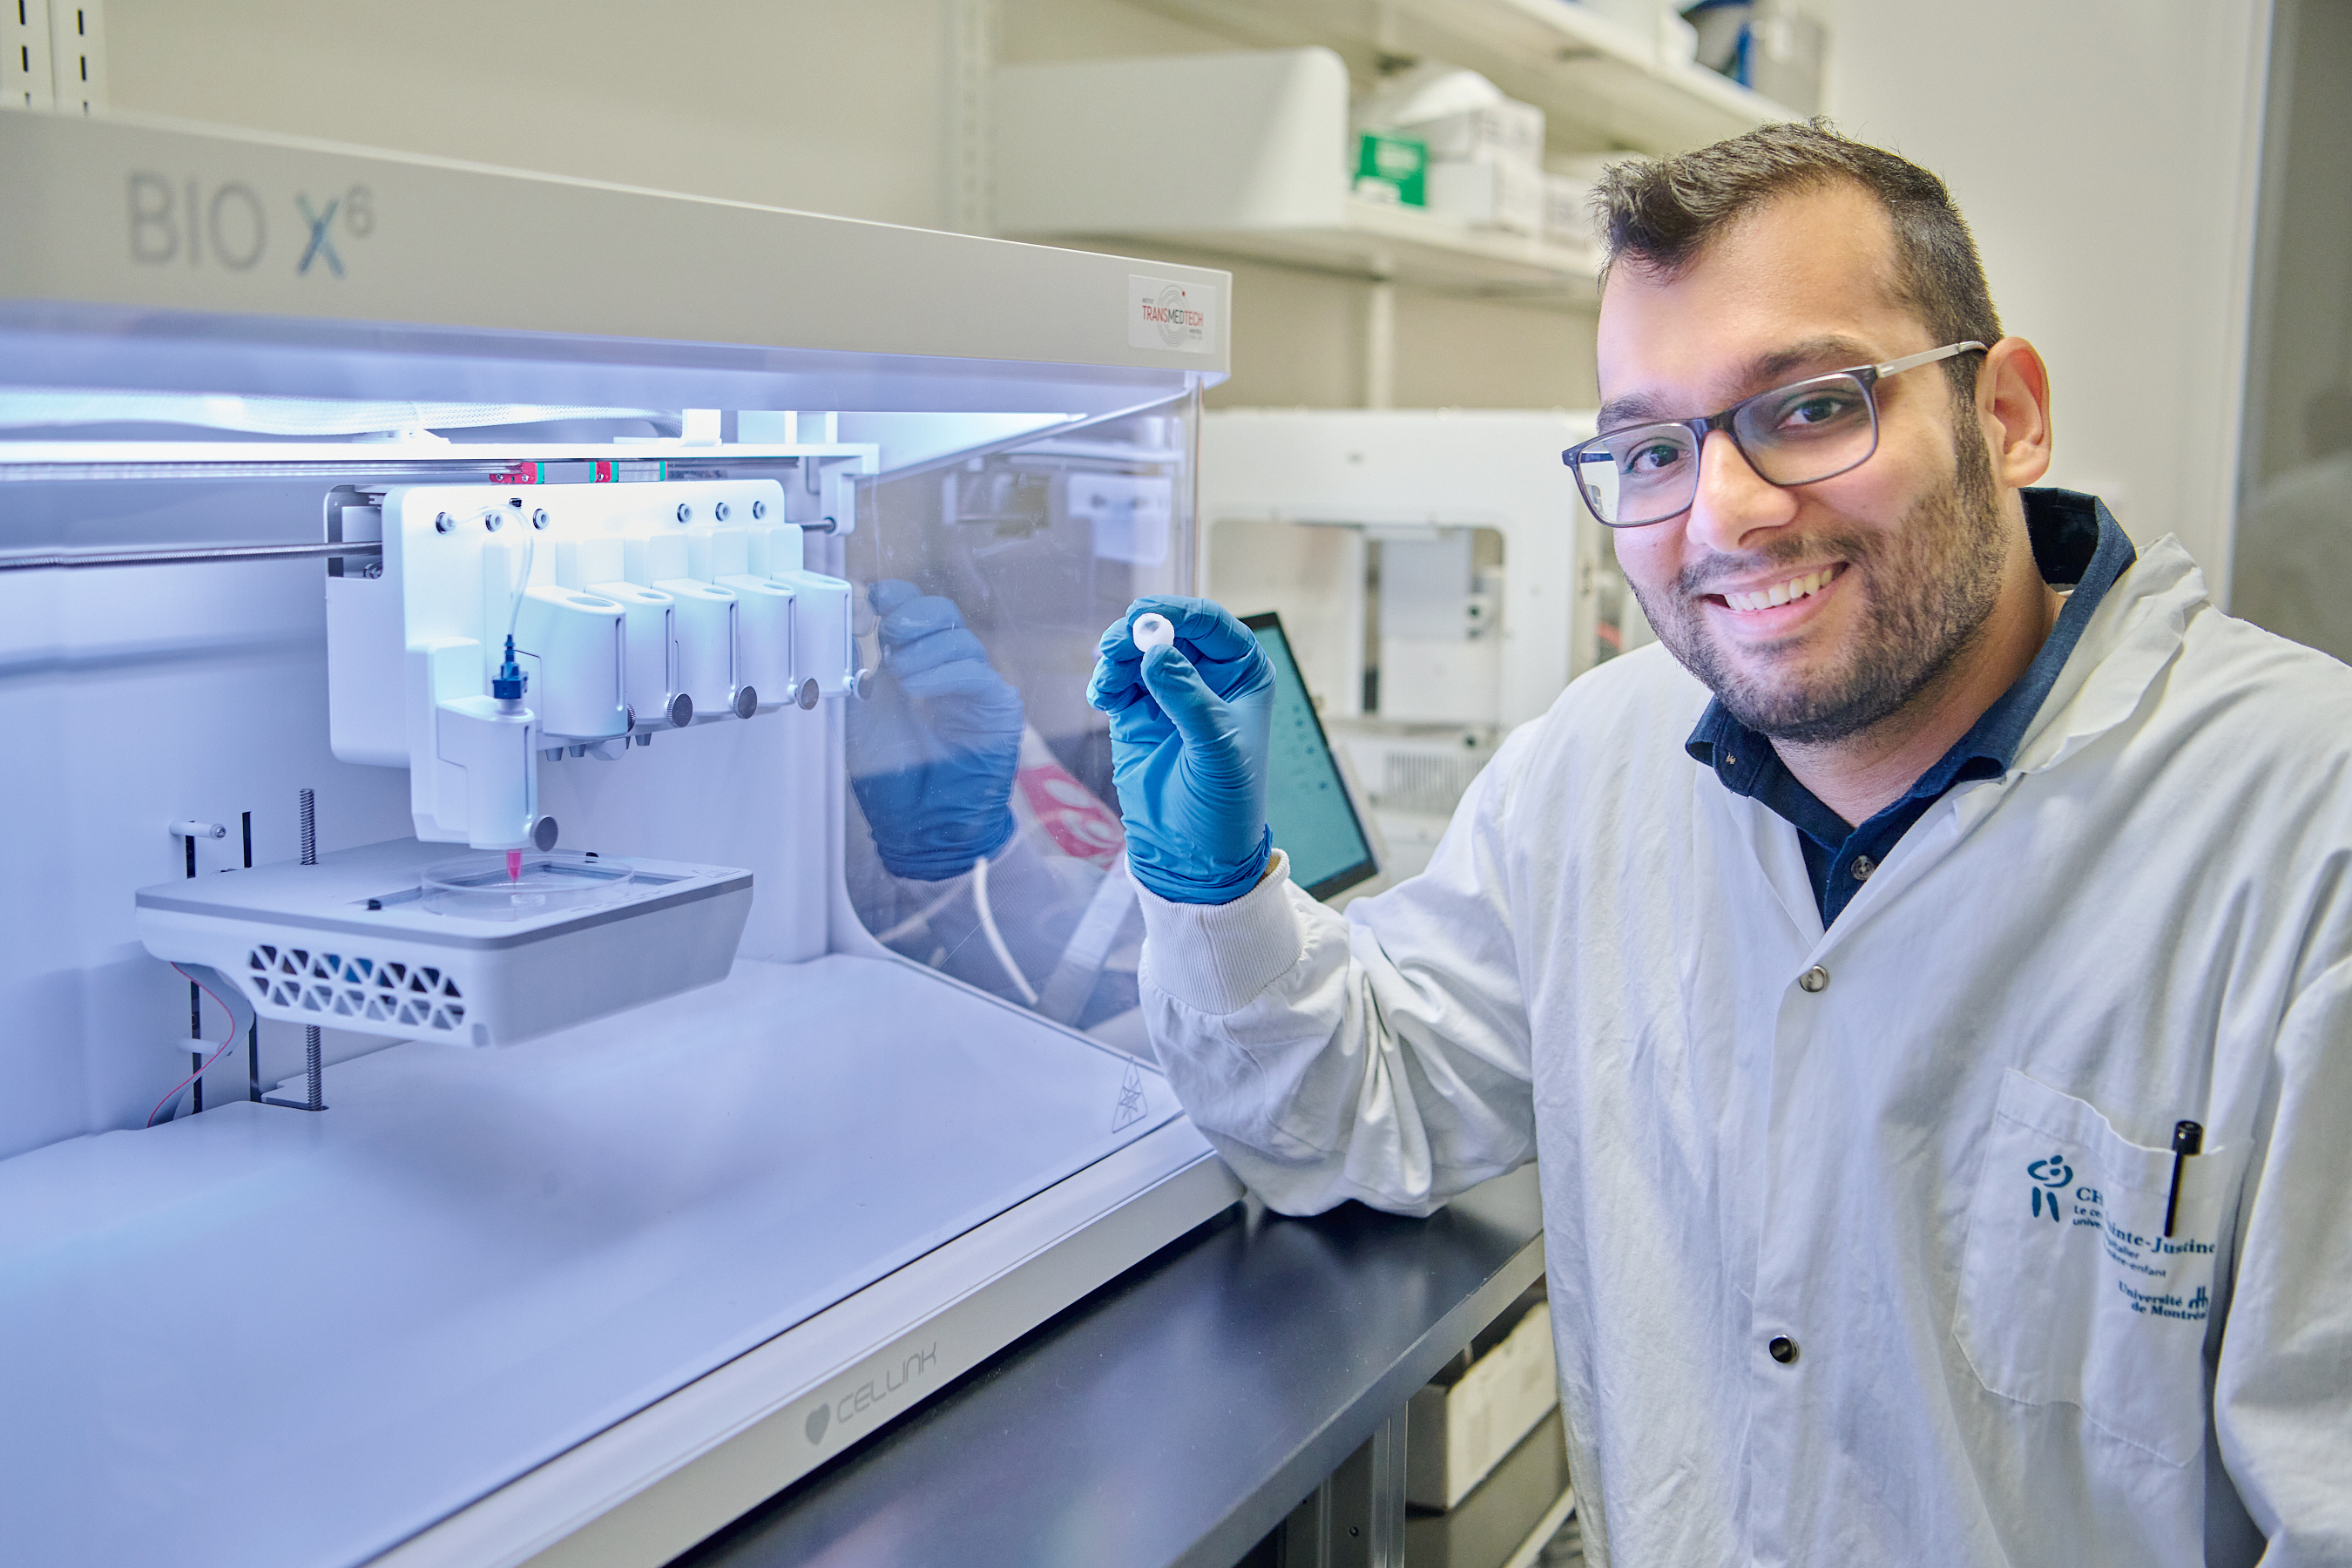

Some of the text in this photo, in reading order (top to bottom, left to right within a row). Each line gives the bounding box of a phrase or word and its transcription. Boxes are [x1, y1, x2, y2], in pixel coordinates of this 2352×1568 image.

[127, 170, 267, 274] BIO
[1142, 305, 1204, 327] TRANSMEDTECH
[2119, 1281, 2183, 1307] Université
[2132, 1301, 2146, 1314] de
[837, 1342, 936, 1423] CELLINK
